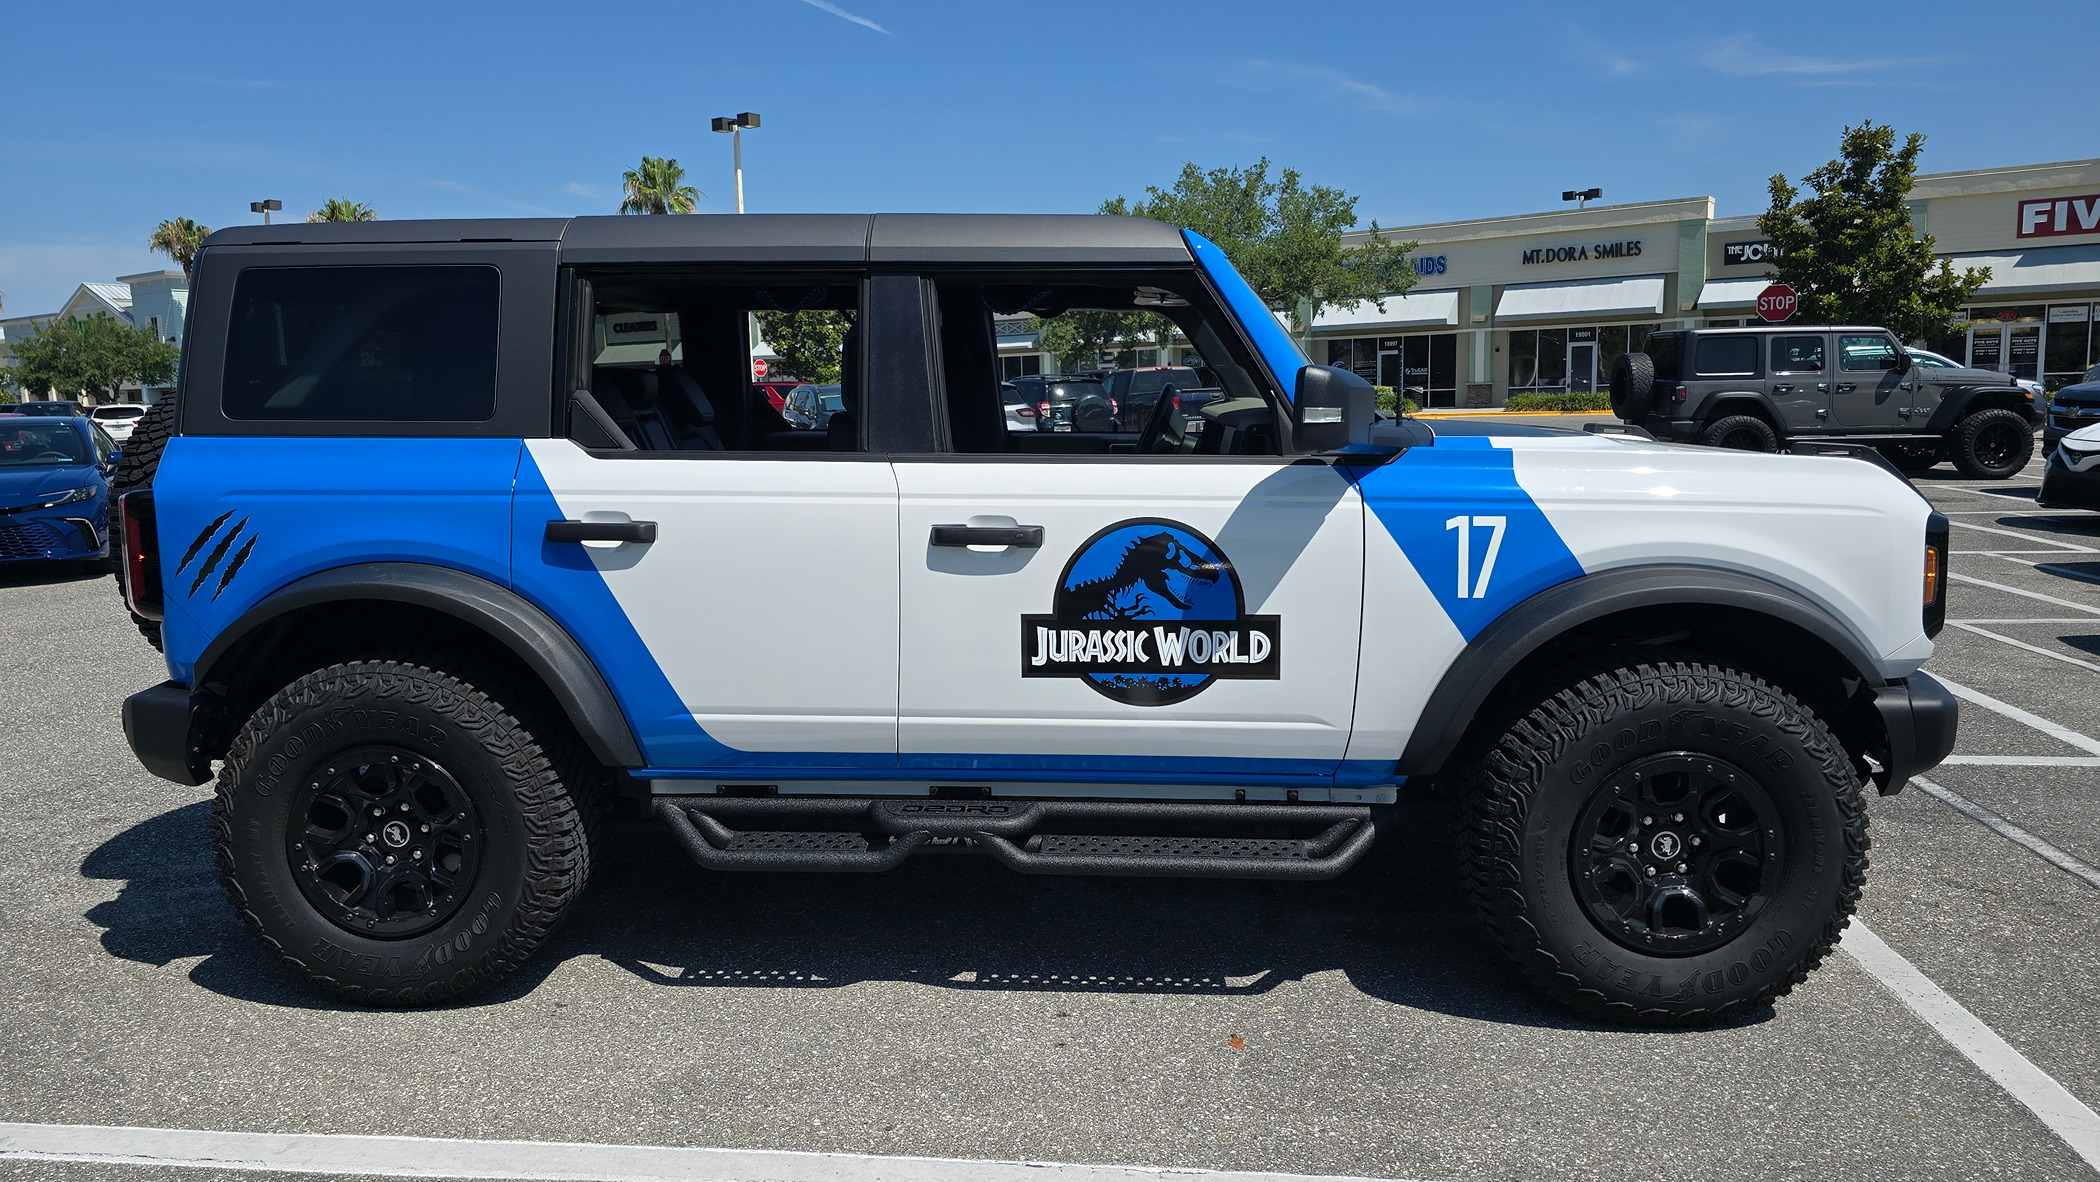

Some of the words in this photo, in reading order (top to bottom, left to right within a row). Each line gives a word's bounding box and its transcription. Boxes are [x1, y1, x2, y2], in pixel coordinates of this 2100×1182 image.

[2022, 198, 2100, 234] FIV
[1594, 240, 1642, 260] SMILES
[1726, 245, 1743, 255] THE
[1759, 295, 1795, 311] STOP
[660, 355, 671, 365] STOP
[754, 364, 767, 372] STOP
[1445, 515, 1507, 599] 17
[1031, 626, 1150, 666] JURASSIC
[1153, 626, 1271, 667] WORLD
